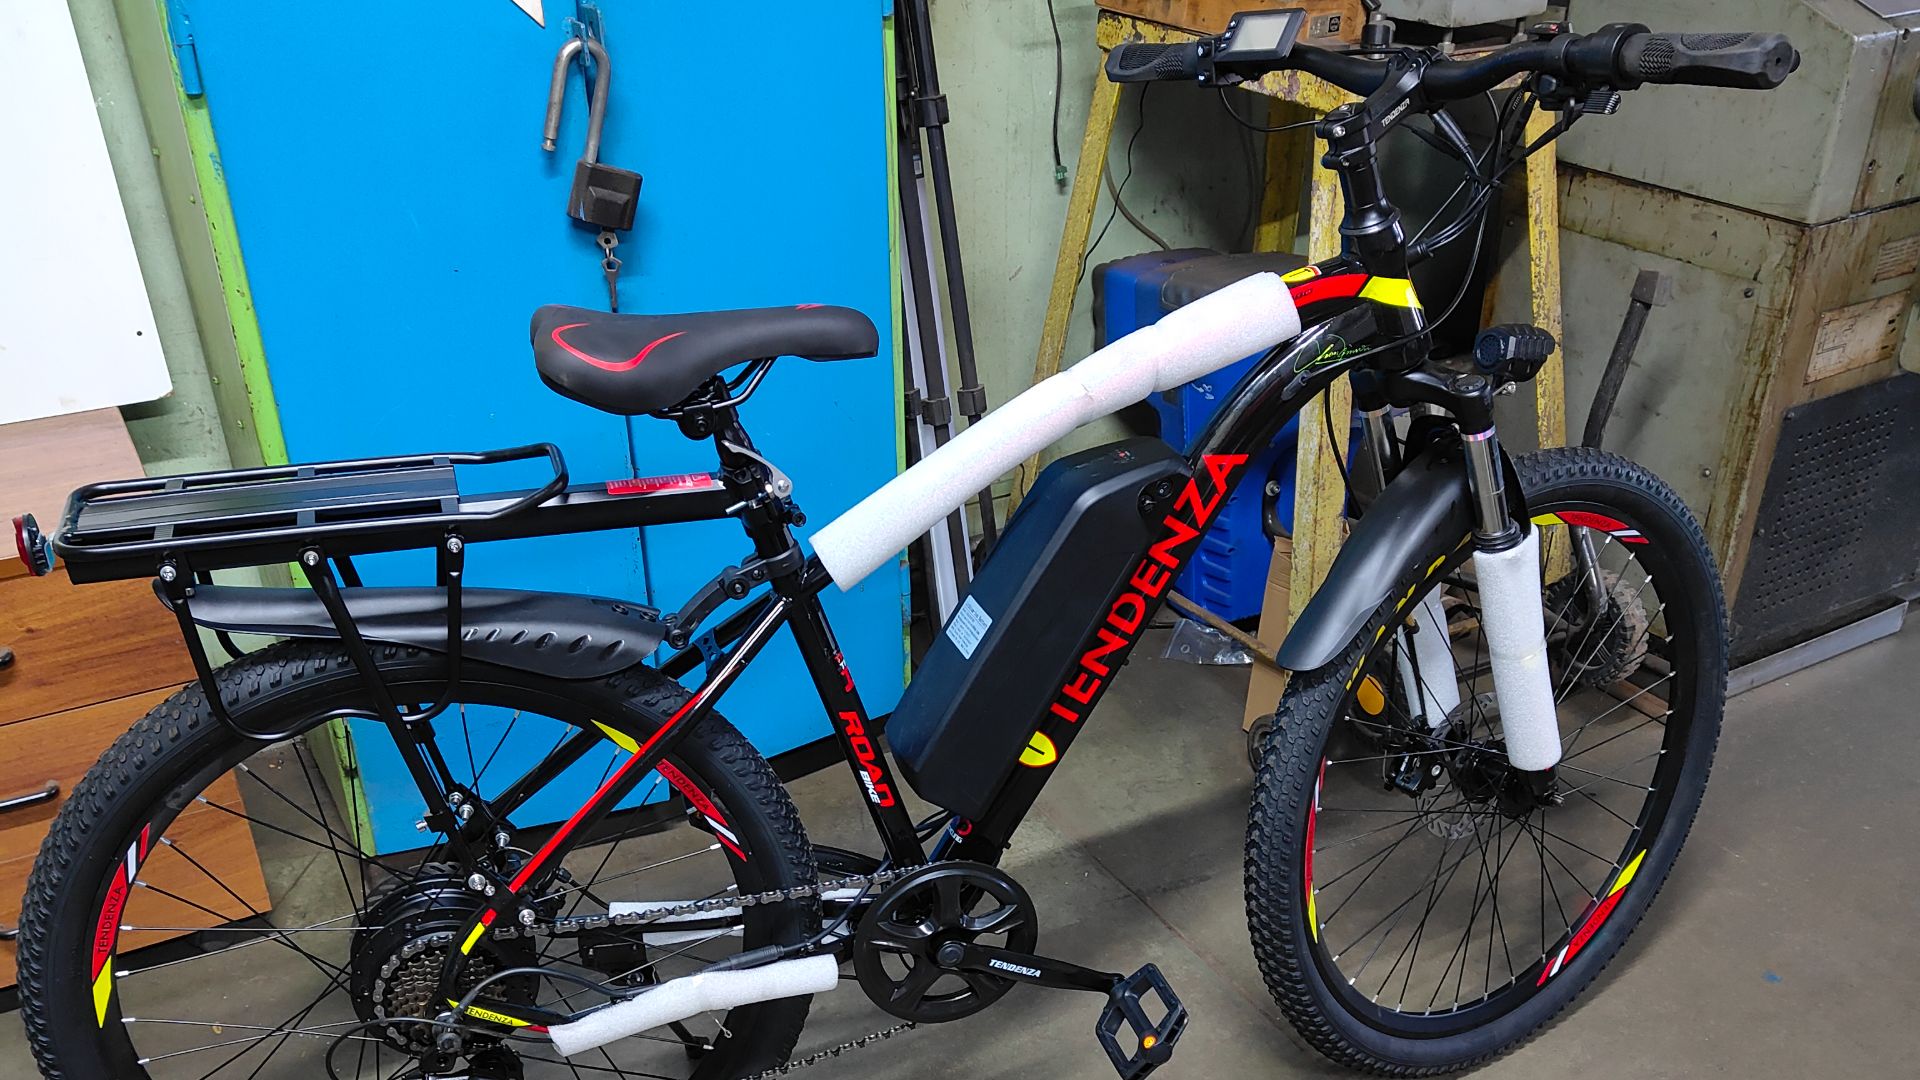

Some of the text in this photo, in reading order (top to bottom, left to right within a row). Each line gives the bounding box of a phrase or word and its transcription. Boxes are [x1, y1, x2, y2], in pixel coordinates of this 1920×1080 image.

[839, 711, 895, 807] ROAD
[859, 769, 881, 804] BIKE
[98, 885, 124, 954] TENDENZA
[988, 959, 1041, 978] TENDENZA
